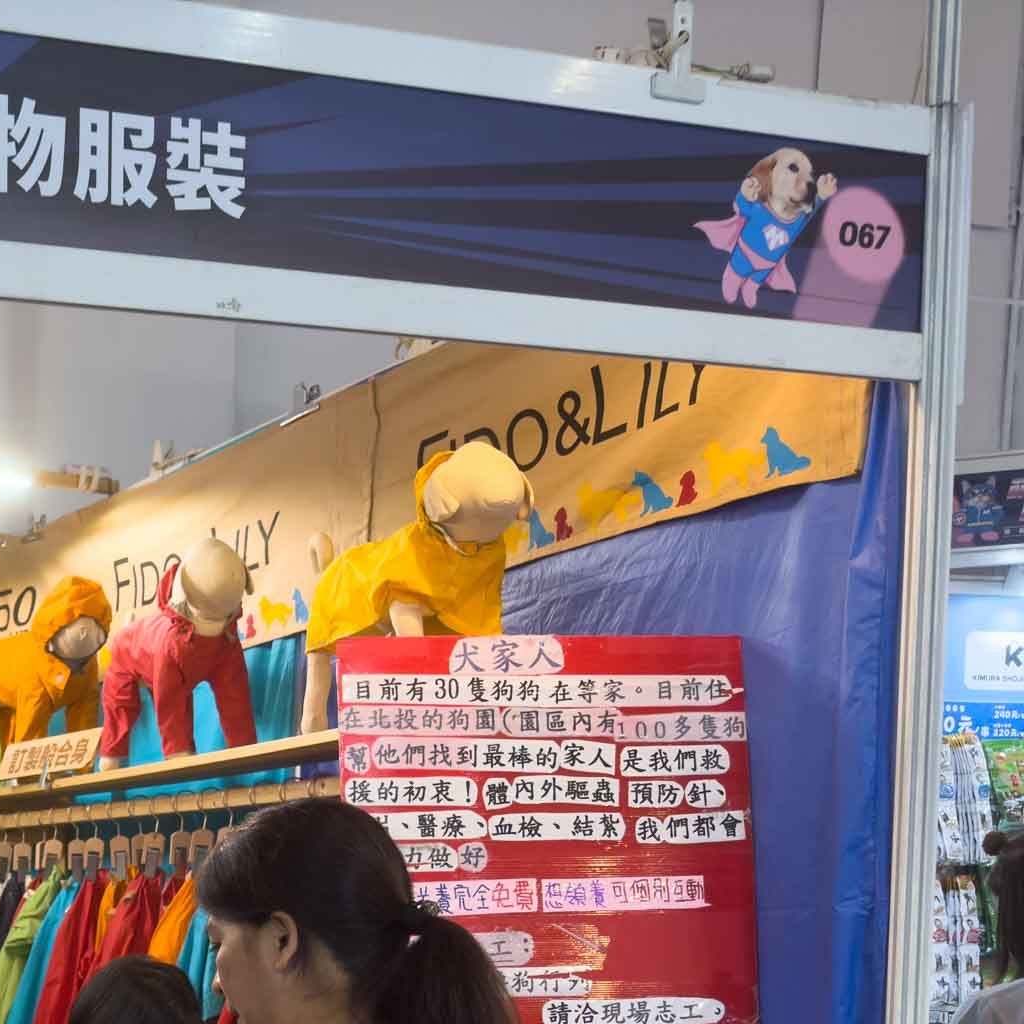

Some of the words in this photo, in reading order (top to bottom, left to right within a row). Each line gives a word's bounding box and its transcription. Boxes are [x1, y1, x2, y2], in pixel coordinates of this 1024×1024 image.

[839, 221, 891, 249] 067
[454, 640, 562, 673] 犬家人
